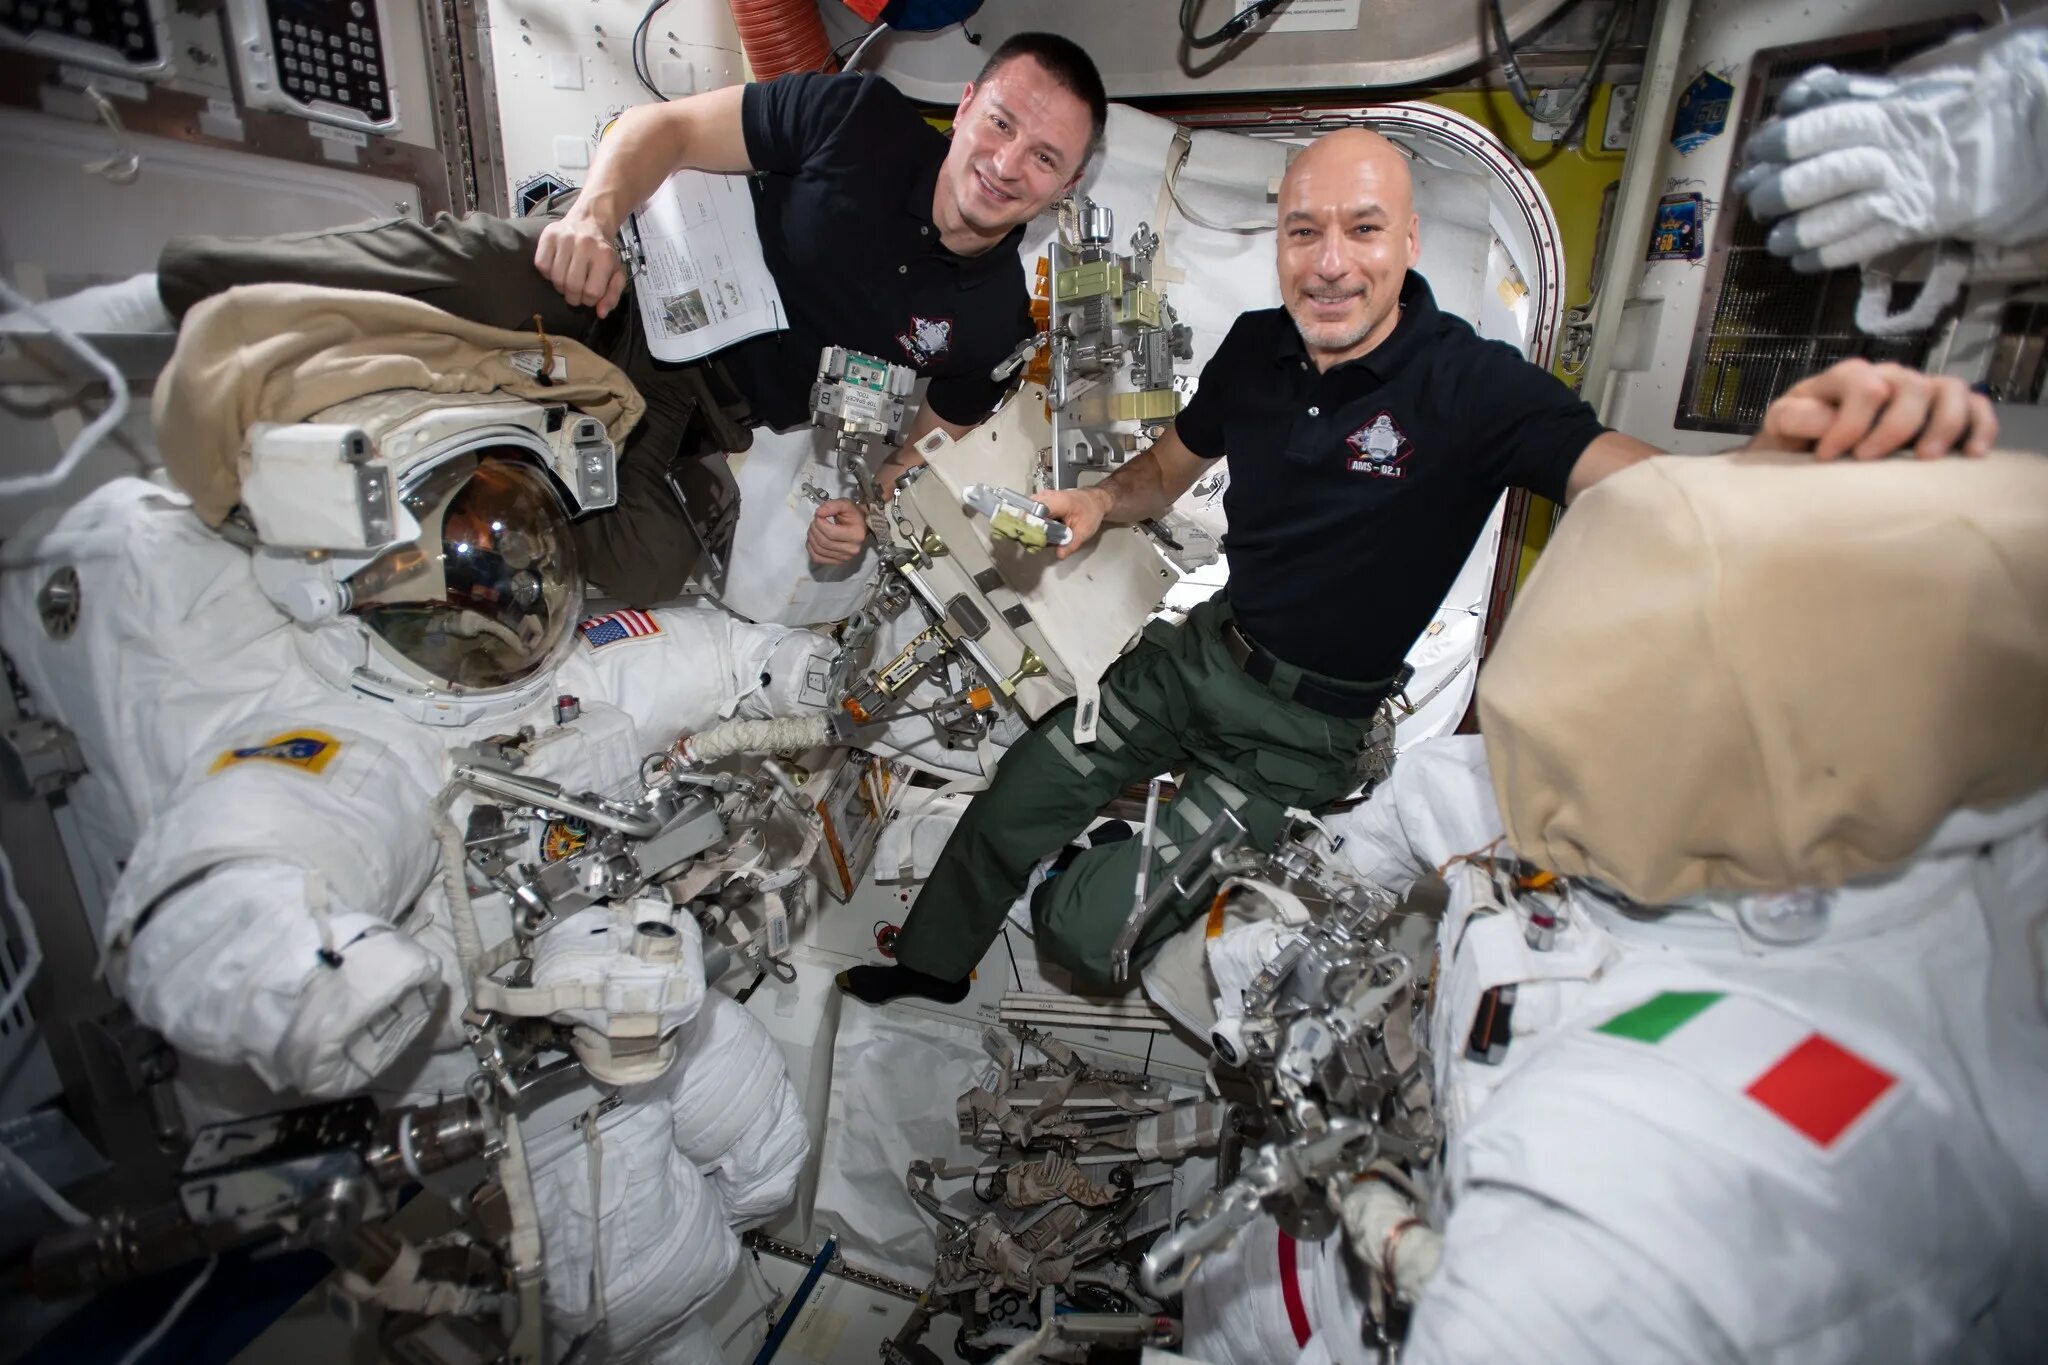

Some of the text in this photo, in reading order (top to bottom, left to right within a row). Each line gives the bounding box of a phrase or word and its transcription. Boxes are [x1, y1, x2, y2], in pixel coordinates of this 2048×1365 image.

[1660, 233, 1674, 252] 59
[820, 391, 831, 405] B
[856, 390, 870, 399] TOOL
[867, 399, 877, 407] TOP
[893, 410, 902, 423] A
[874, 422, 883, 433] C
